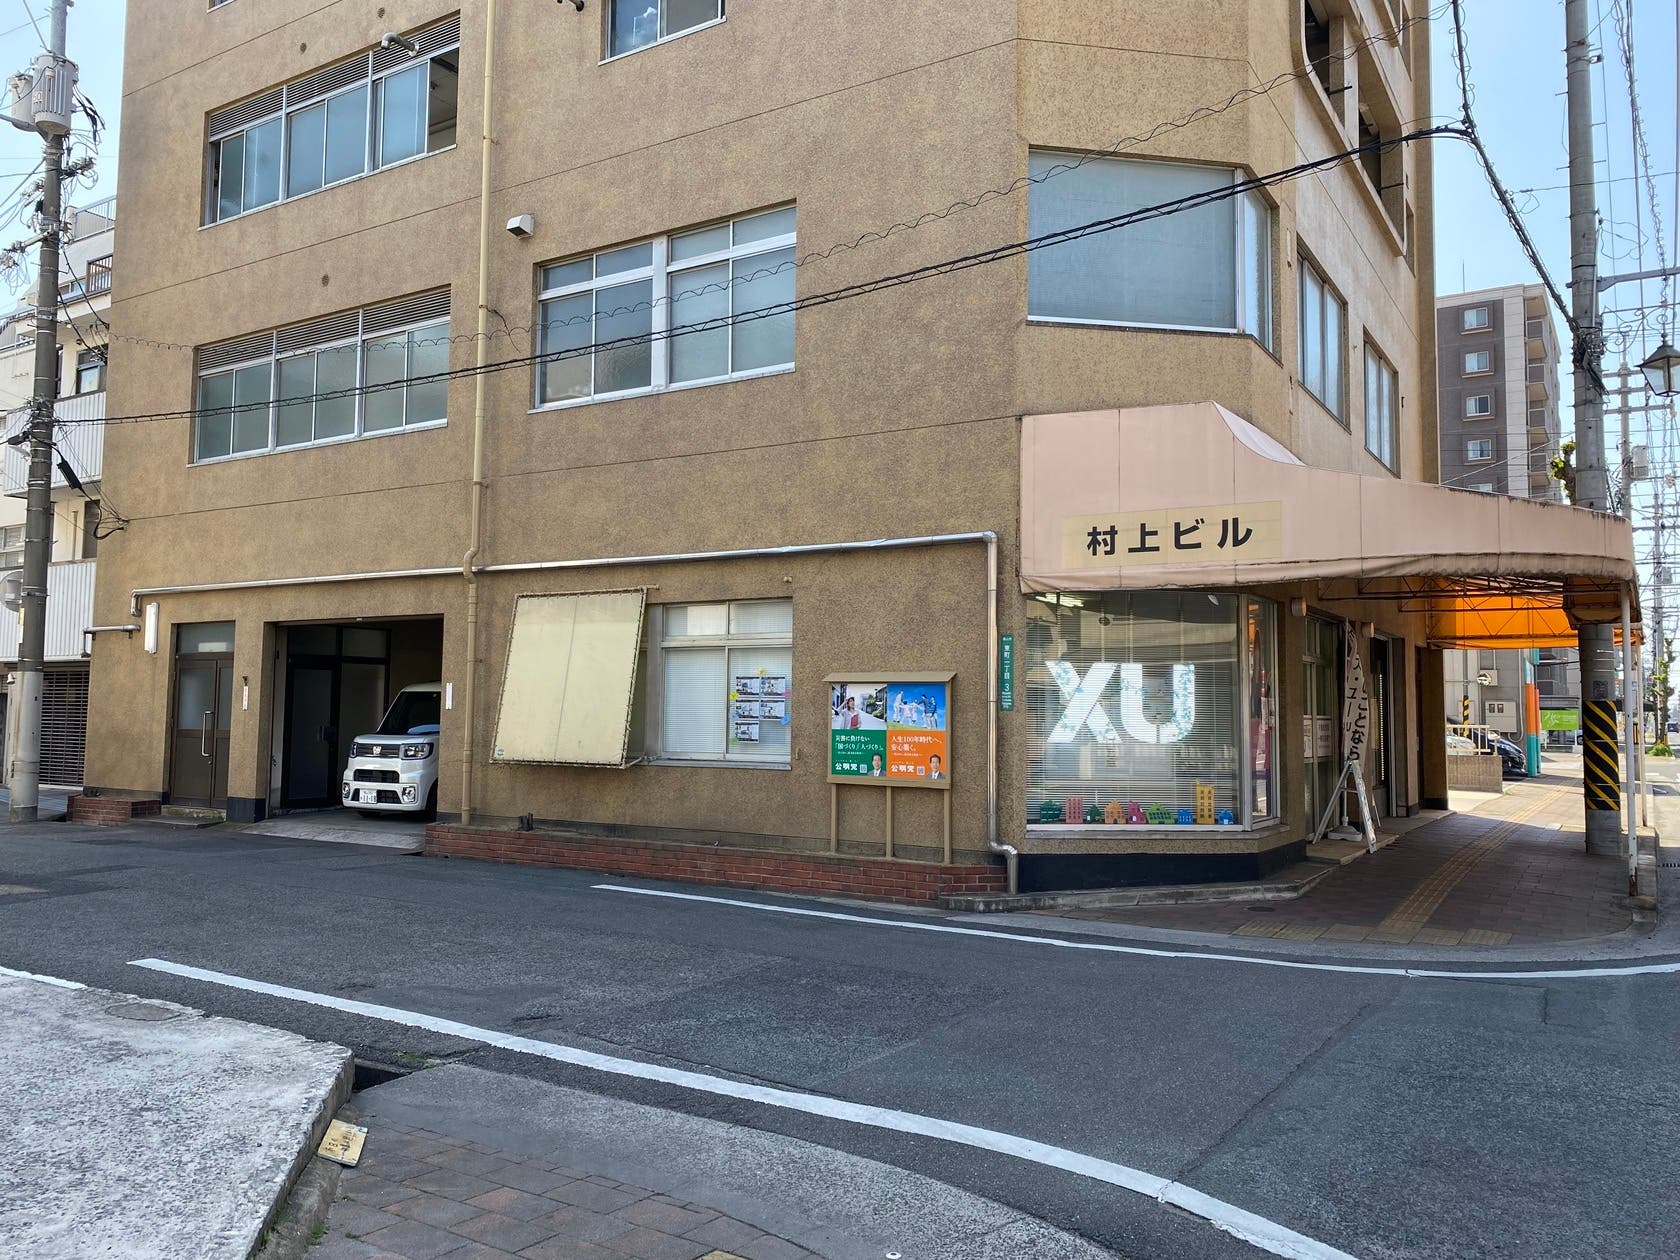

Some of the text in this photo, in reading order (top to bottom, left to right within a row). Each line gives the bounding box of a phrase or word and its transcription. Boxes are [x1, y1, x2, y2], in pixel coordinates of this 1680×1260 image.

[1086, 517, 1253, 556] 村上ビル
[1044, 660, 1196, 744] XU
[835, 762, 858, 771] 公明党
[890, 764, 915, 773] 公明党
